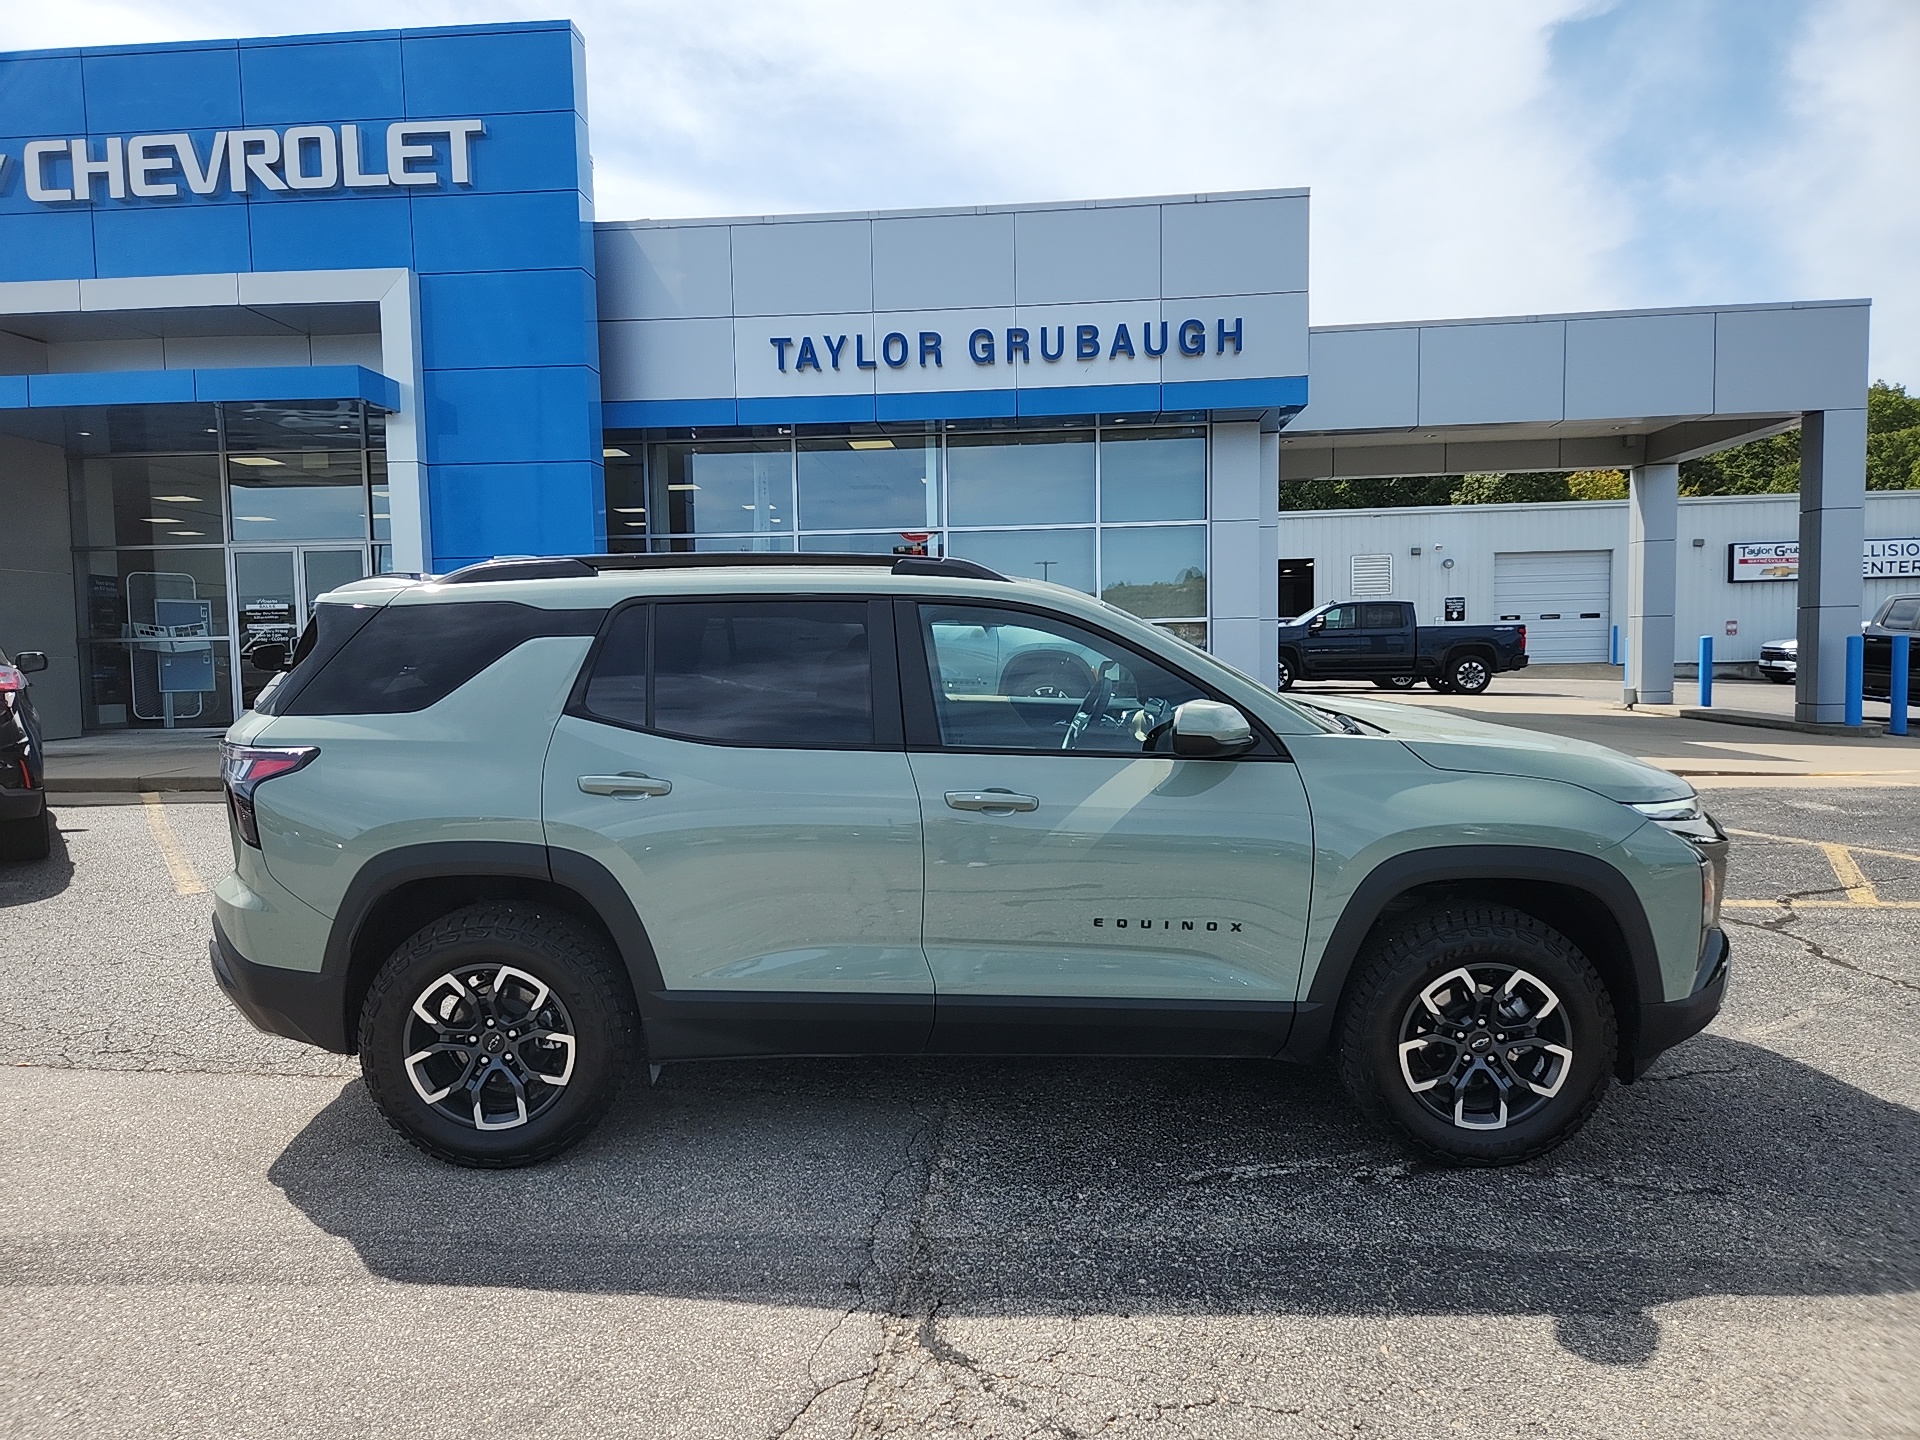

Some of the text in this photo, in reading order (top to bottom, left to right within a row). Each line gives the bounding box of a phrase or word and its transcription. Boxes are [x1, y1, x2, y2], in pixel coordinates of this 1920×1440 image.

[23, 119, 486, 202] CHEVROLET
[769, 316, 1244, 373] TAYLOR GRUBAUGH
[1739, 545, 1773, 557] Taylor
[1863, 543, 1920, 557] LISIO
[1093, 917, 1243, 933] EQUINOX
